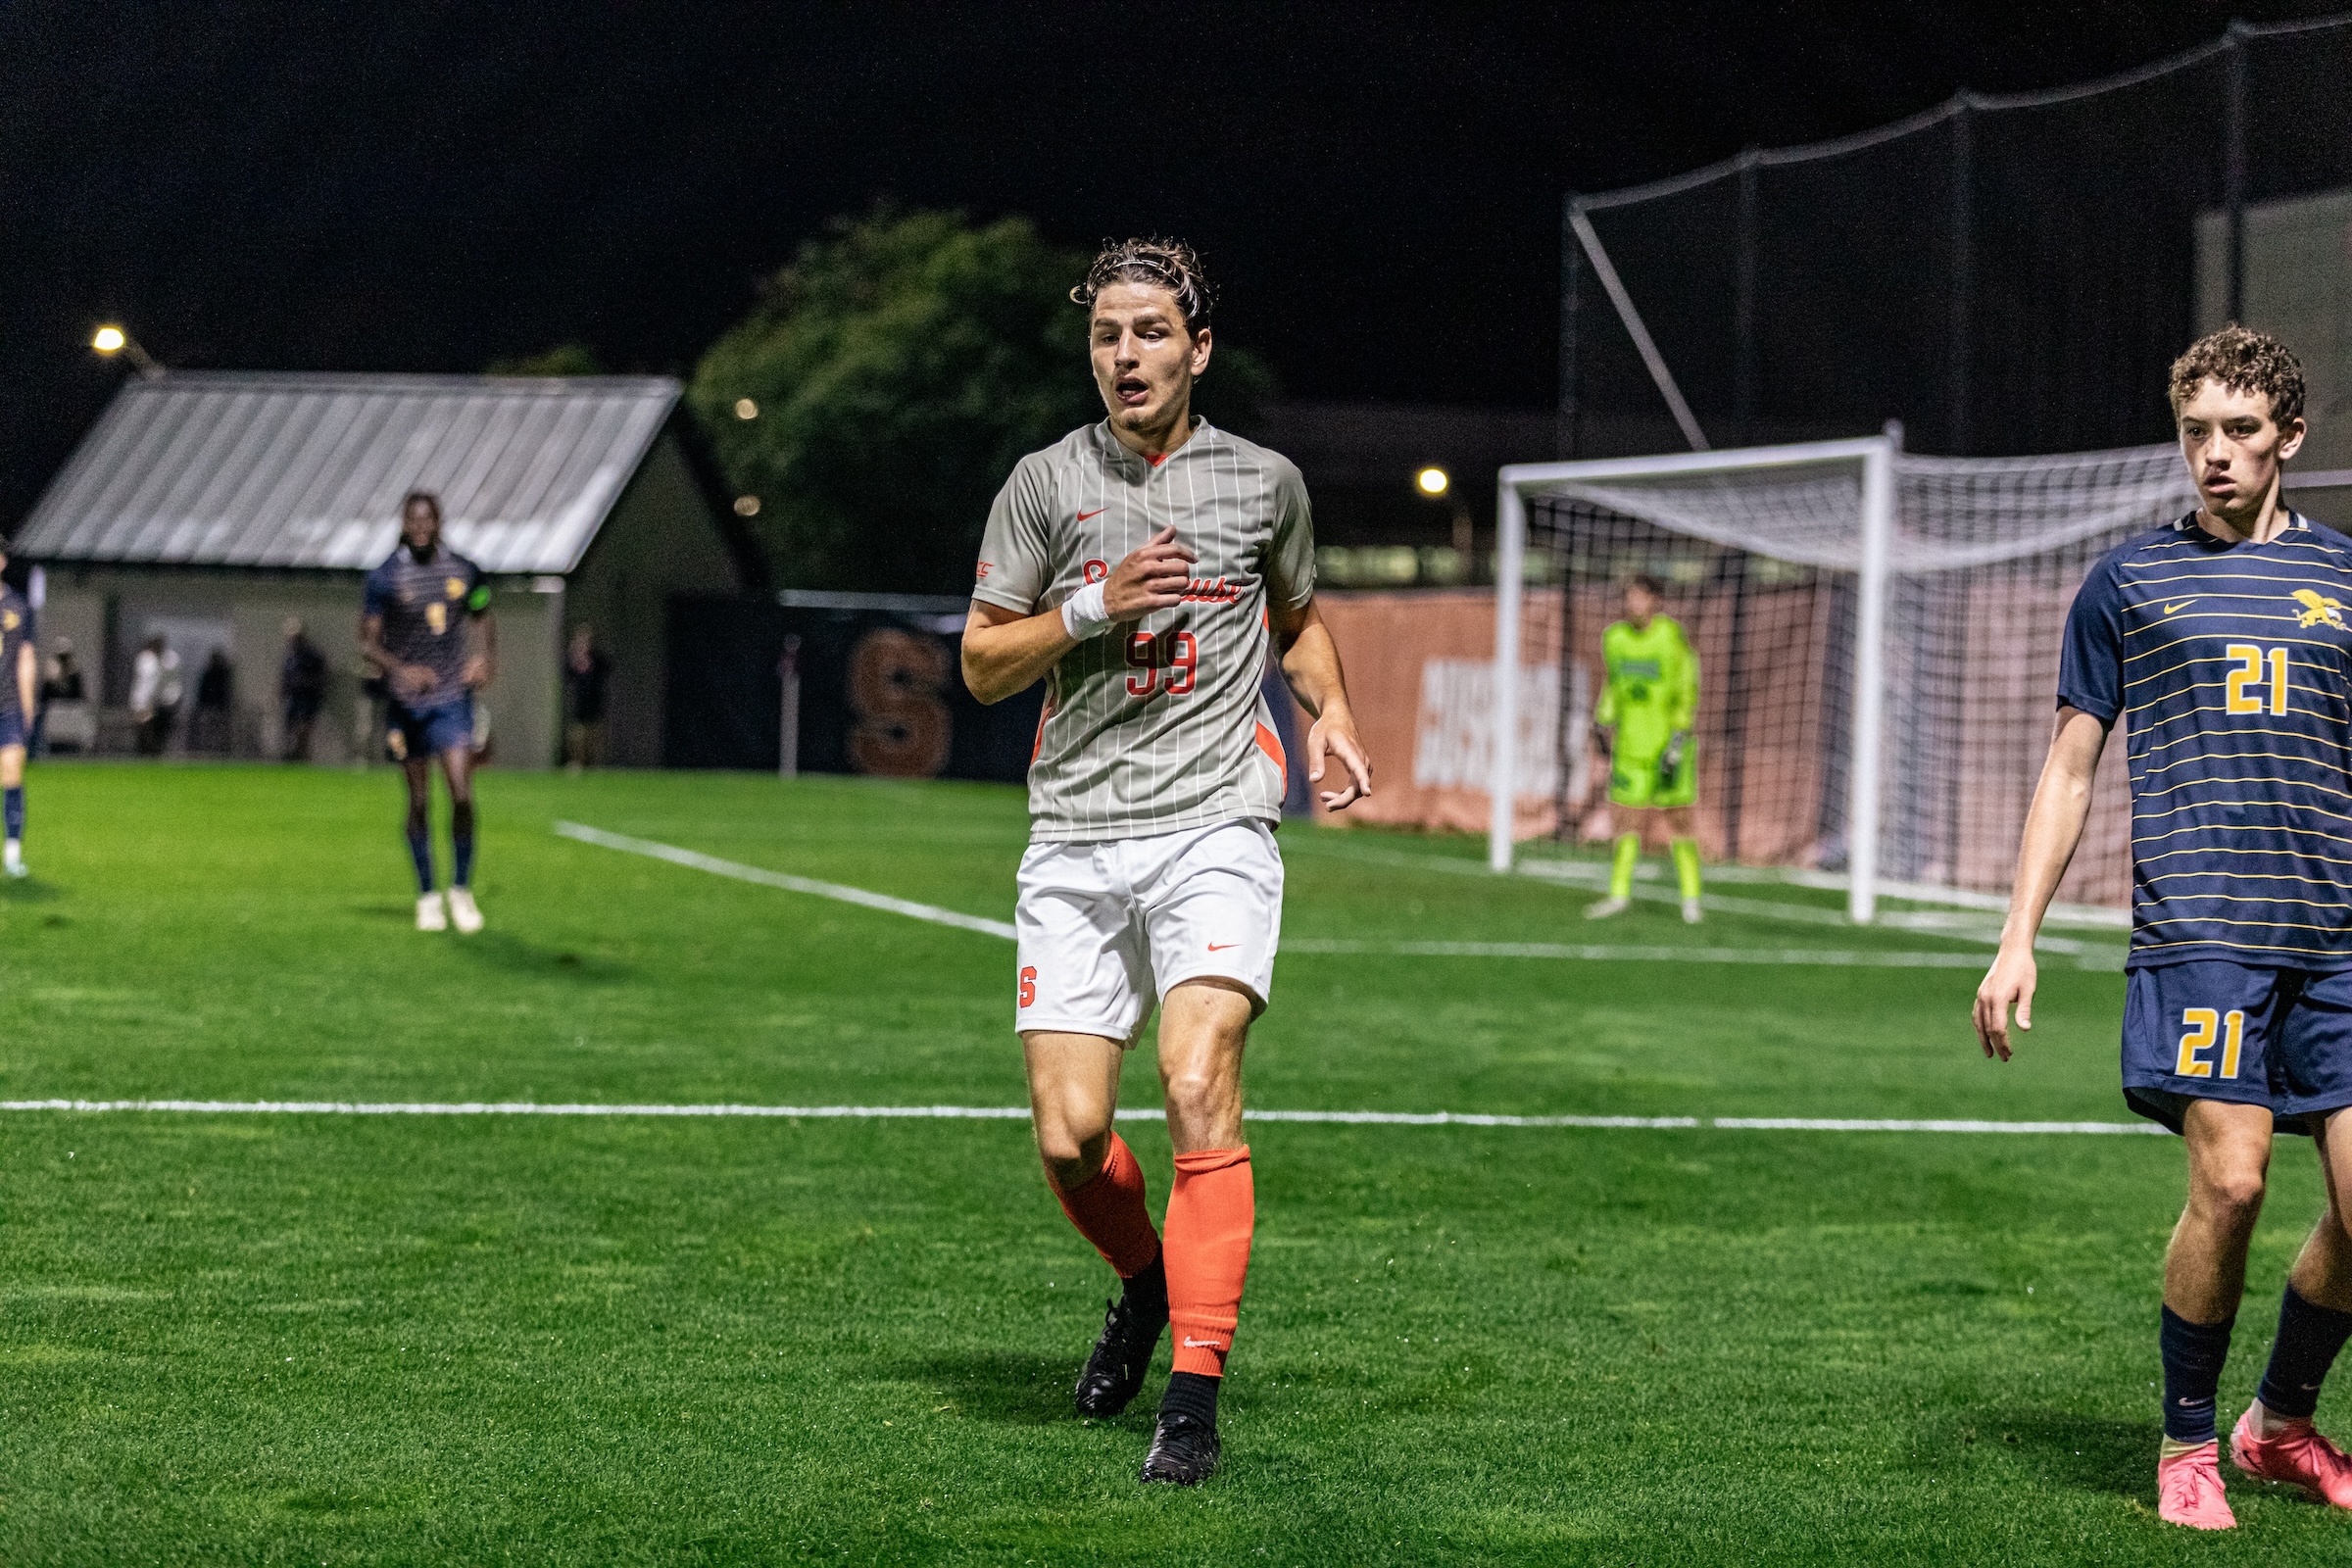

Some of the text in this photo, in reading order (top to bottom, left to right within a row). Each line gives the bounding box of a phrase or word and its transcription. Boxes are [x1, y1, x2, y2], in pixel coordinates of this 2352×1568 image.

[1125, 630, 1199, 697] 99
[2226, 644, 2288, 716] 21
[848, 628, 953, 777] S
[1019, 965, 1037, 1008] S
[2175, 1007, 2244, 1079] 21
